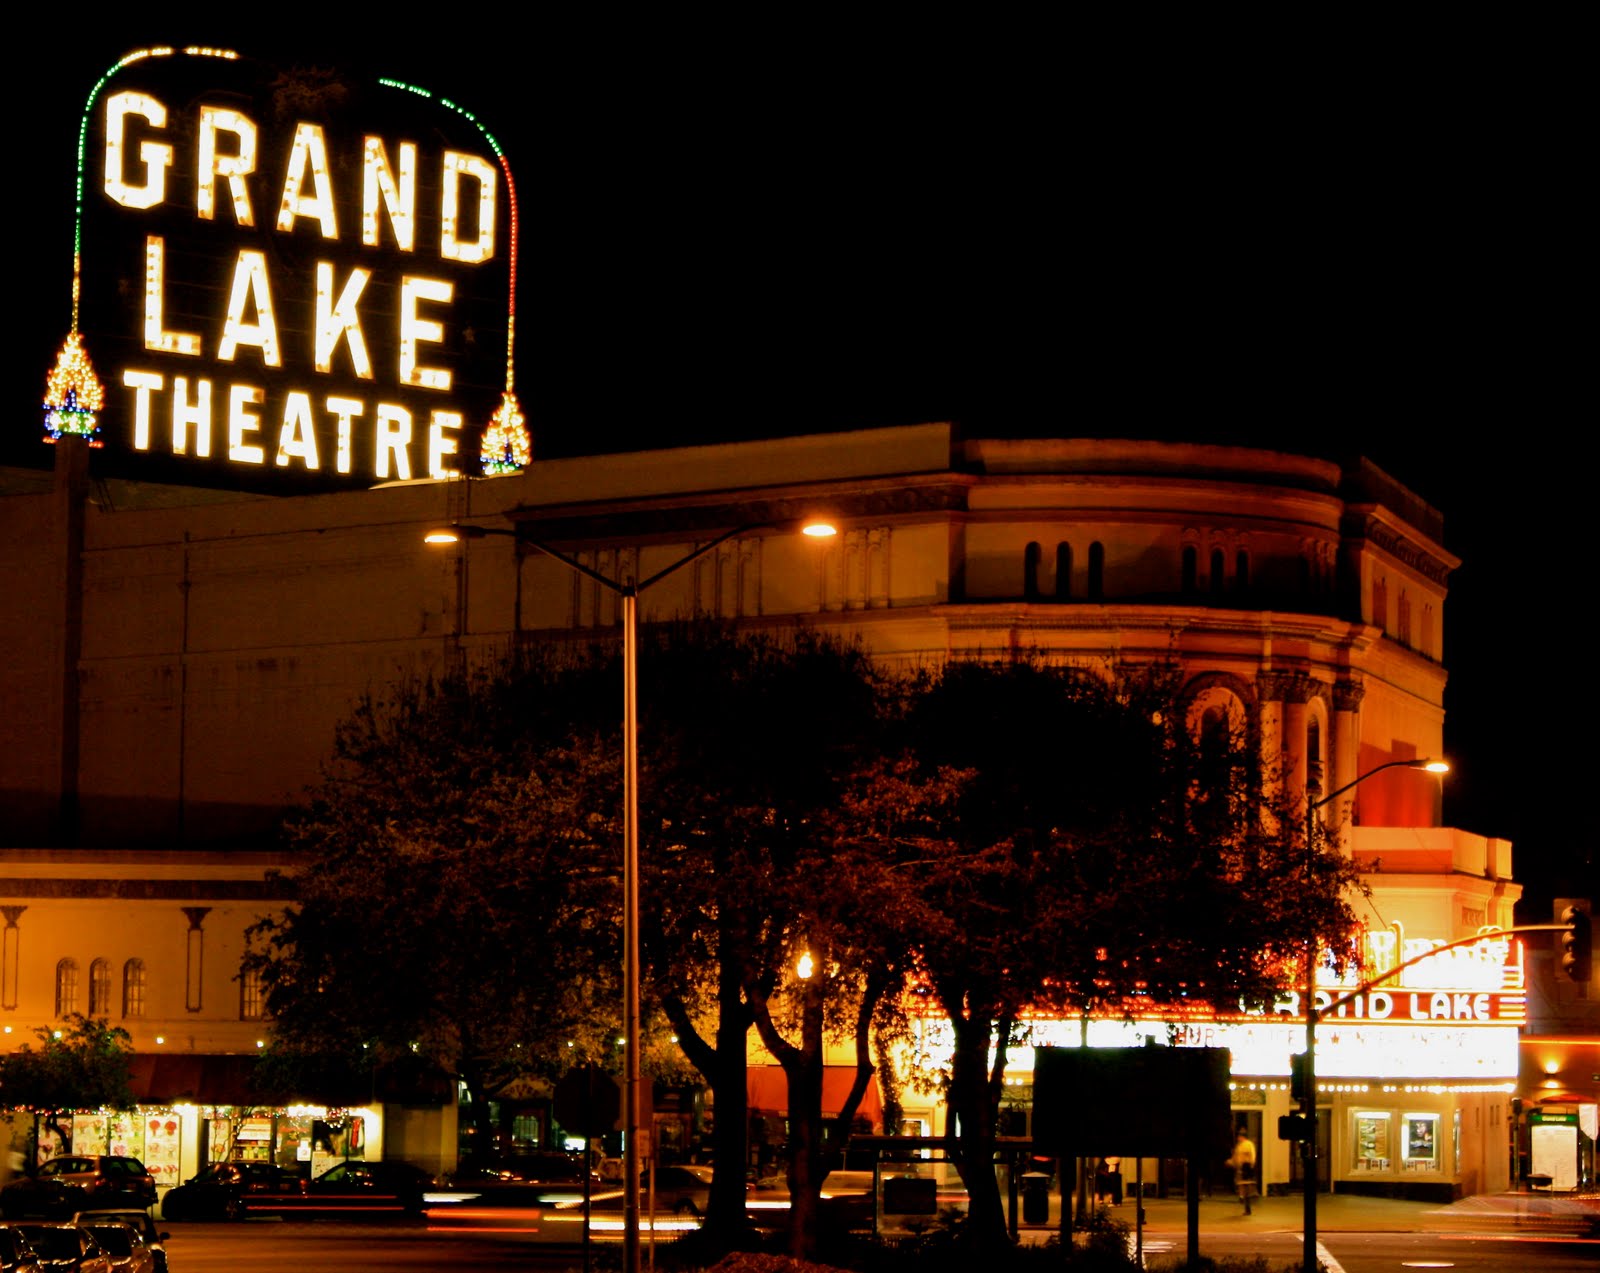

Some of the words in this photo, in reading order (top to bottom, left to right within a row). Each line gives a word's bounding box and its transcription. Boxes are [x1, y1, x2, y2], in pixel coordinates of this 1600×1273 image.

[103, 90, 498, 264] GRAND
[144, 236, 455, 391] LAKE
[123, 370, 463, 481] THEATRE
[1409, 992, 1490, 1020] LAKE
